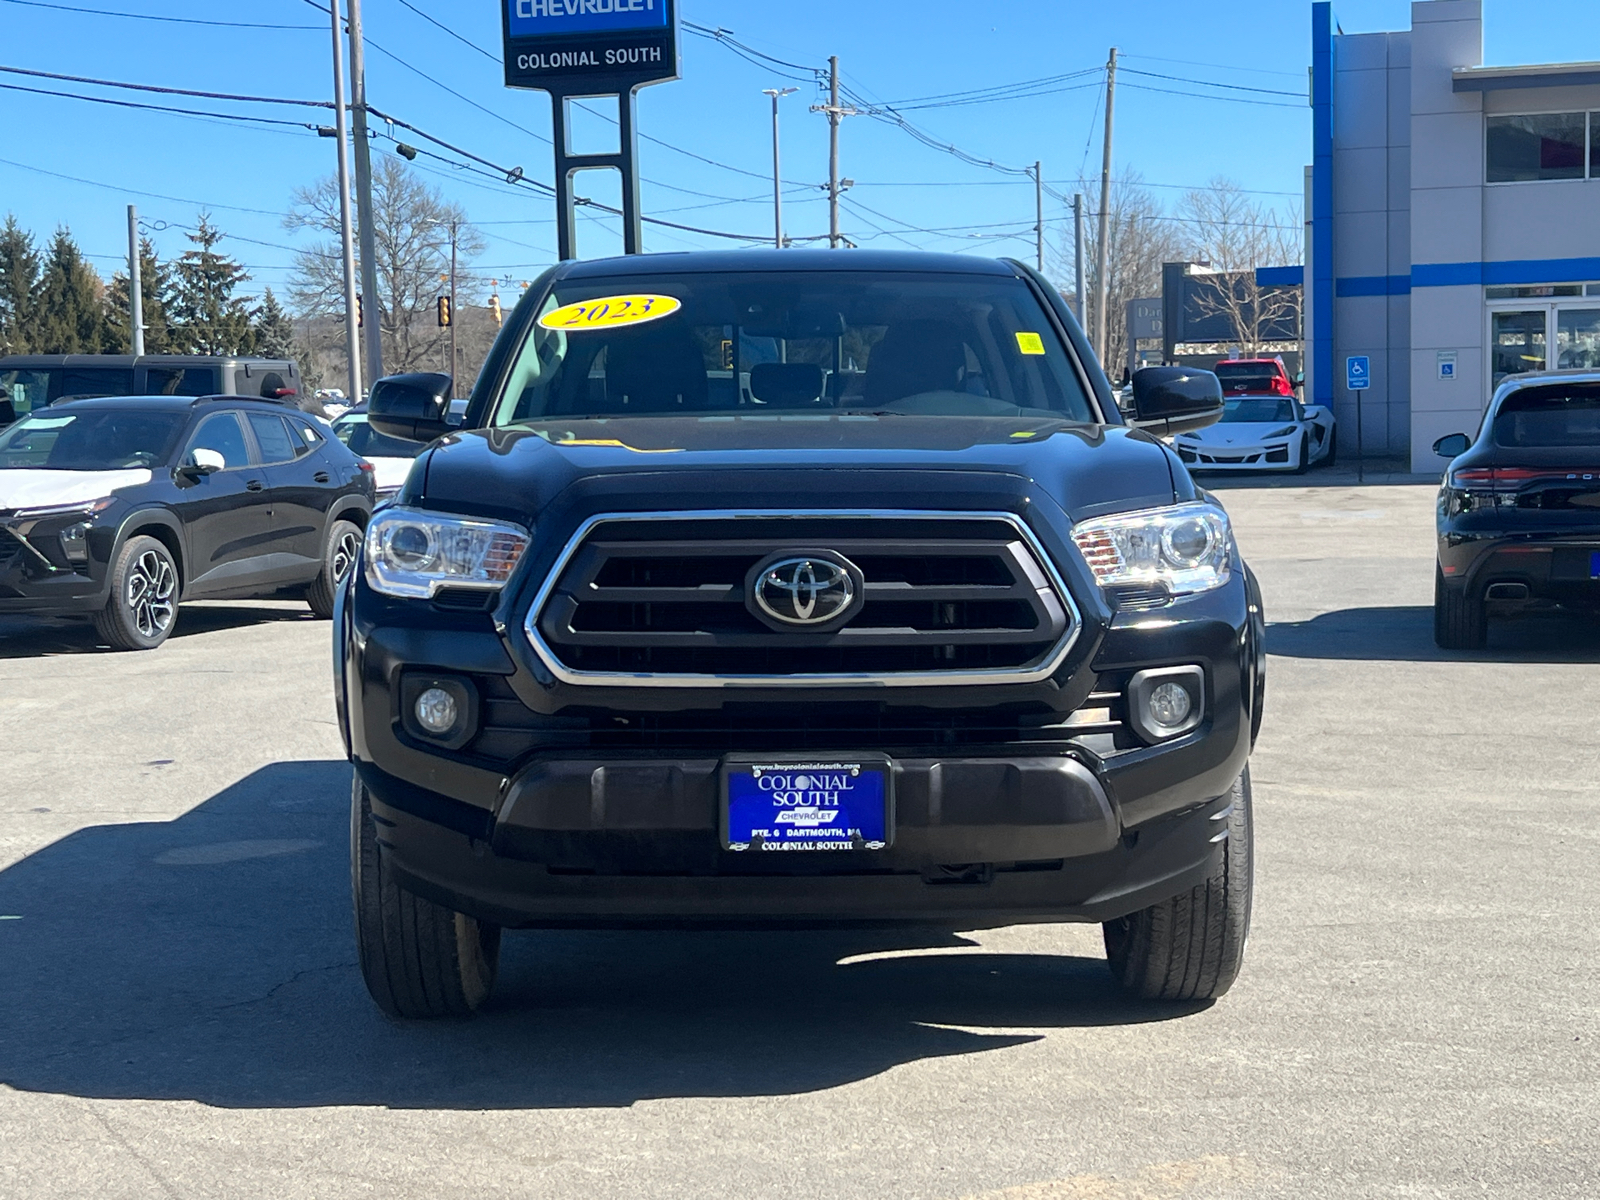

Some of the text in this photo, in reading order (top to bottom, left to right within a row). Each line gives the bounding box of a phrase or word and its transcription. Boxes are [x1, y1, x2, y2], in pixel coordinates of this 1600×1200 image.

[517, 47, 661, 70] COLONIAL SOUTH
[562, 298, 655, 326] 2023
[752, 763, 861, 772] www.buycolonialsouth.com
[757, 774, 854, 791] COLONIAL
[772, 791, 839, 806] SOUTH
[781, 812, 831, 820] CHEVROLET
[773, 828, 780, 837] 6
[786, 828, 846, 838] DARTMOUTH,
[761, 841, 854, 851] COLONIAL SOUTH
